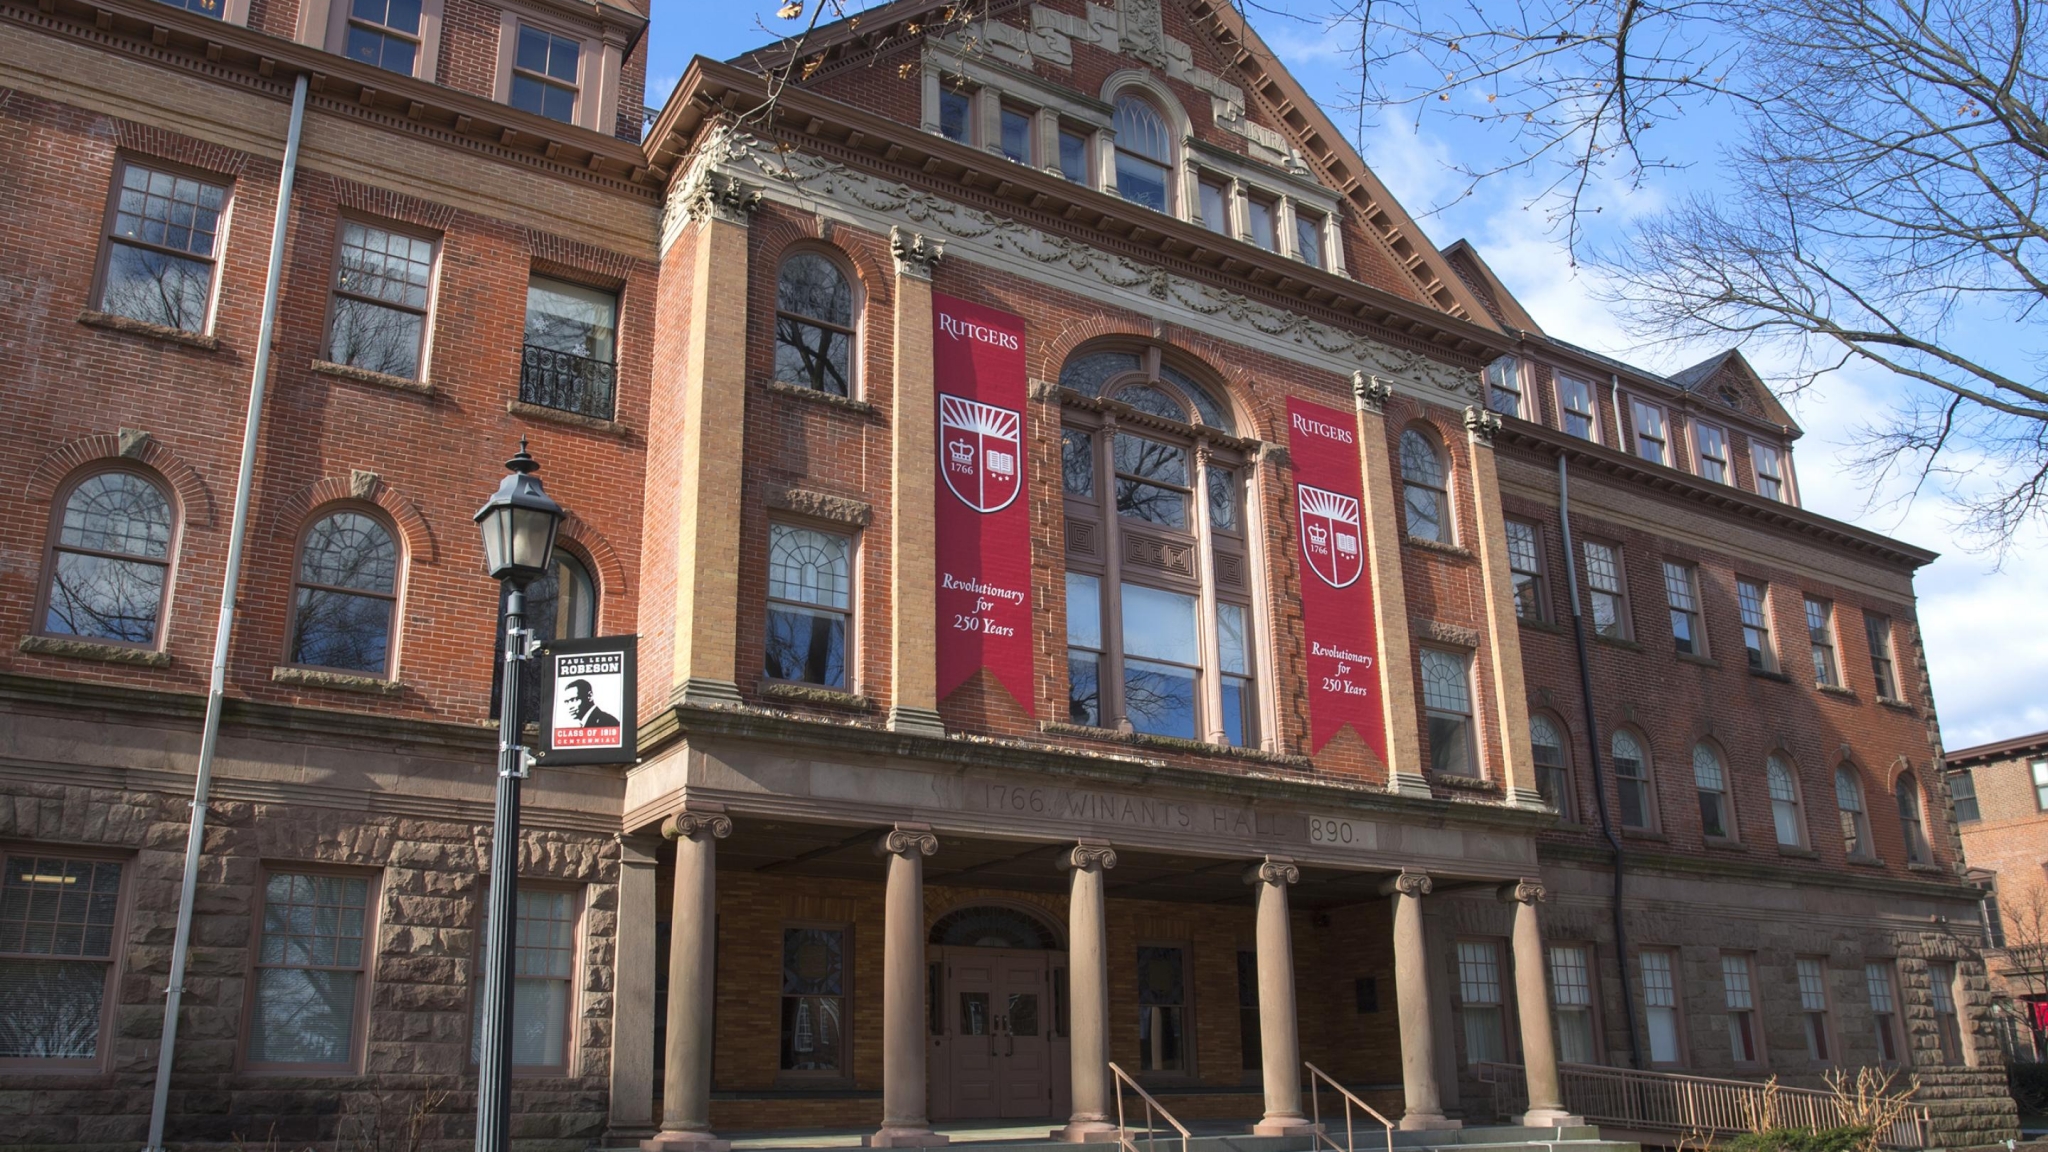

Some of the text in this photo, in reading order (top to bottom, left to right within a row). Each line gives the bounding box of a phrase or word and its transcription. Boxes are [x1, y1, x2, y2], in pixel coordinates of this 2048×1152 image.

[939, 313, 1019, 350] RUTGERS
[1292, 413, 1353, 444] RUTGERS
[950, 462, 974, 476] 1766
[1310, 543, 1328, 555] 1766
[942, 572, 1025, 605] Revolutionary
[972, 597, 994, 615] for
[953, 614, 1015, 638] 250 Years
[1311, 641, 1373, 668] Revolutionary
[561, 663, 619, 675] ROBESON
[1335, 661, 1351, 677] for
[1322, 677, 1367, 697] 250 Years
[557, 729, 584, 738] CLASS
[587, 729, 597, 738] OF
[1065, 791, 1190, 827] WINANTS
[1211, 807, 1286, 837] HALL
